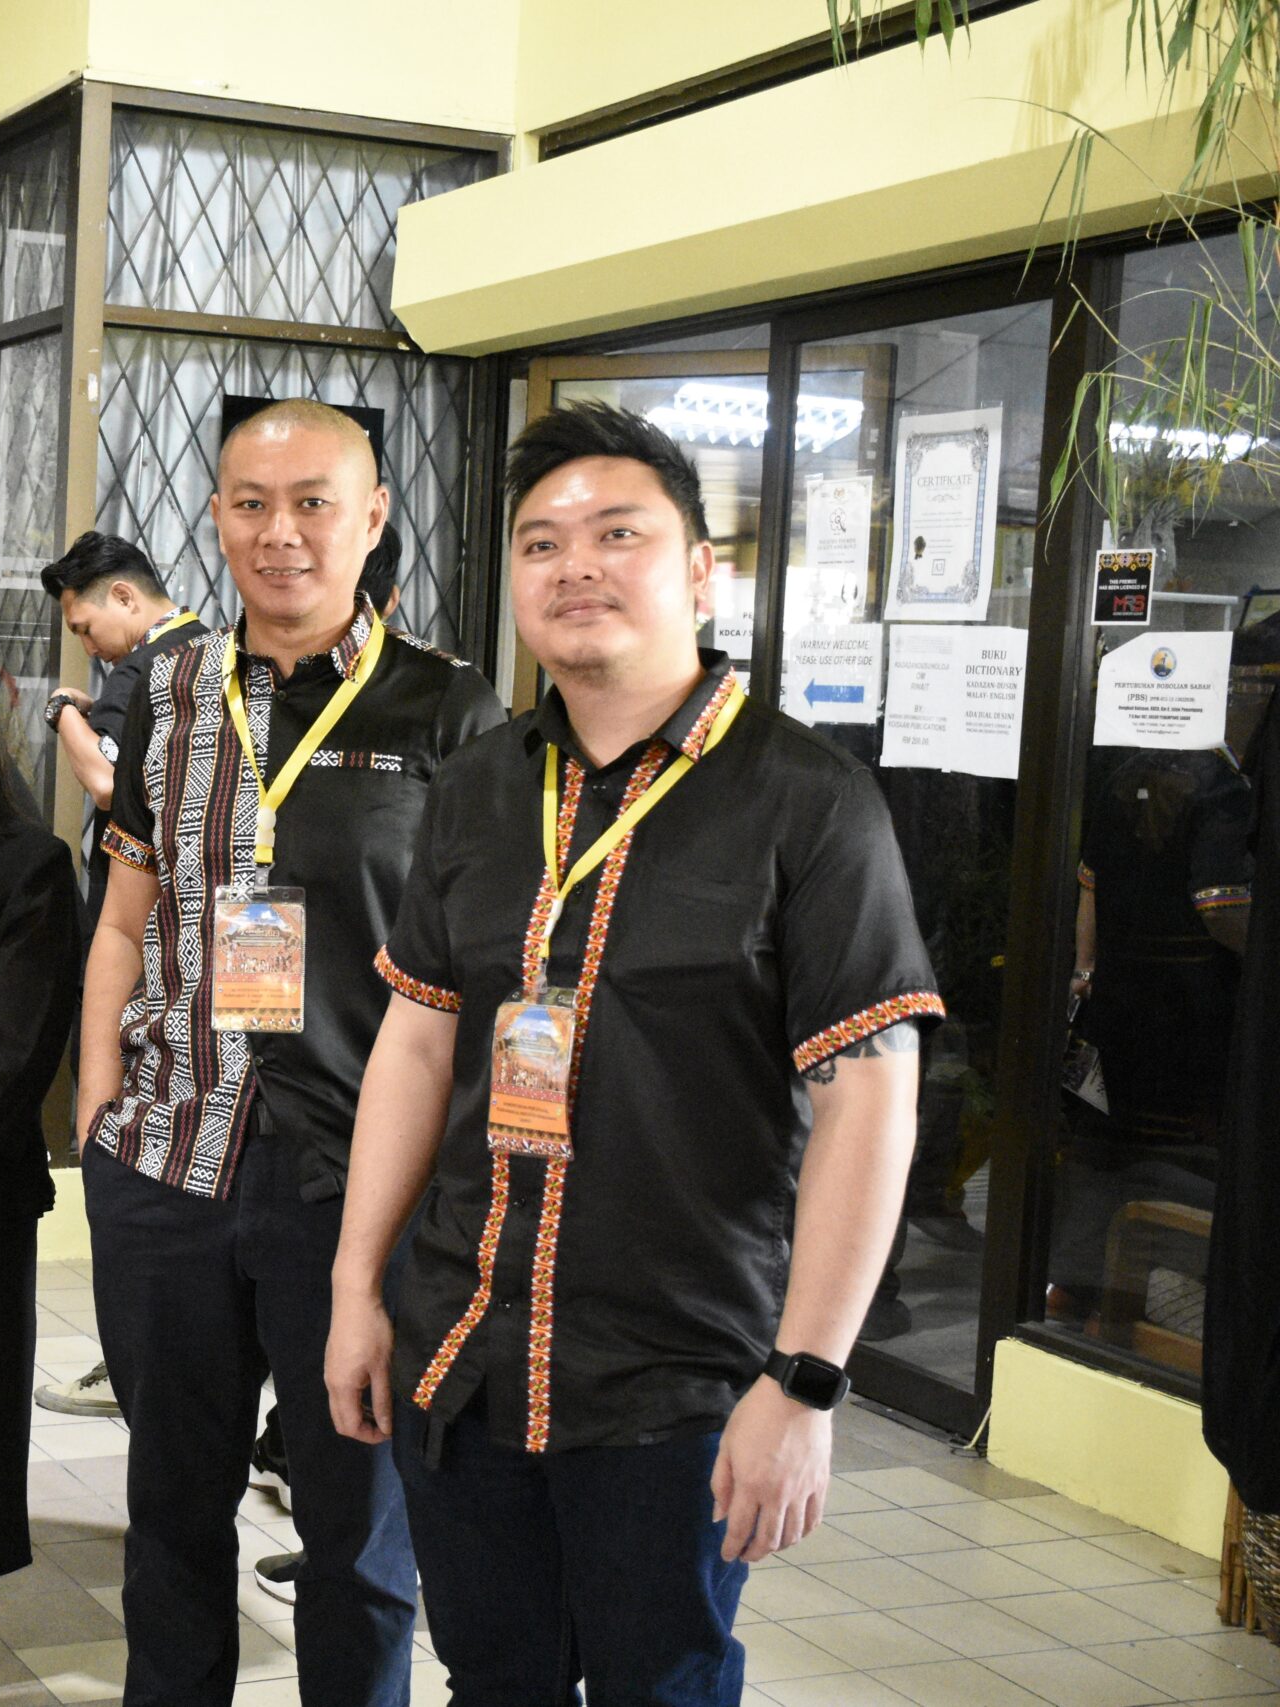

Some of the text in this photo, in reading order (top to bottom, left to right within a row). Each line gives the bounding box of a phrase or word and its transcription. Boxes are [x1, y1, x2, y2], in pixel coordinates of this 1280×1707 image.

[917, 474, 974, 488] CERTIFICATE
[720, 629, 741, 637] KDCA
[800, 640, 870, 650] WARMLY WELCOME
[795, 655, 873, 665] PLEASE USE OTHER SIDE
[981, 650, 1008, 661] BUKU
[965, 665, 1023, 677] DICTIONARY
[989, 692, 1017, 701] ENGLISH
[1127, 693, 1148, 703] (PBS)
